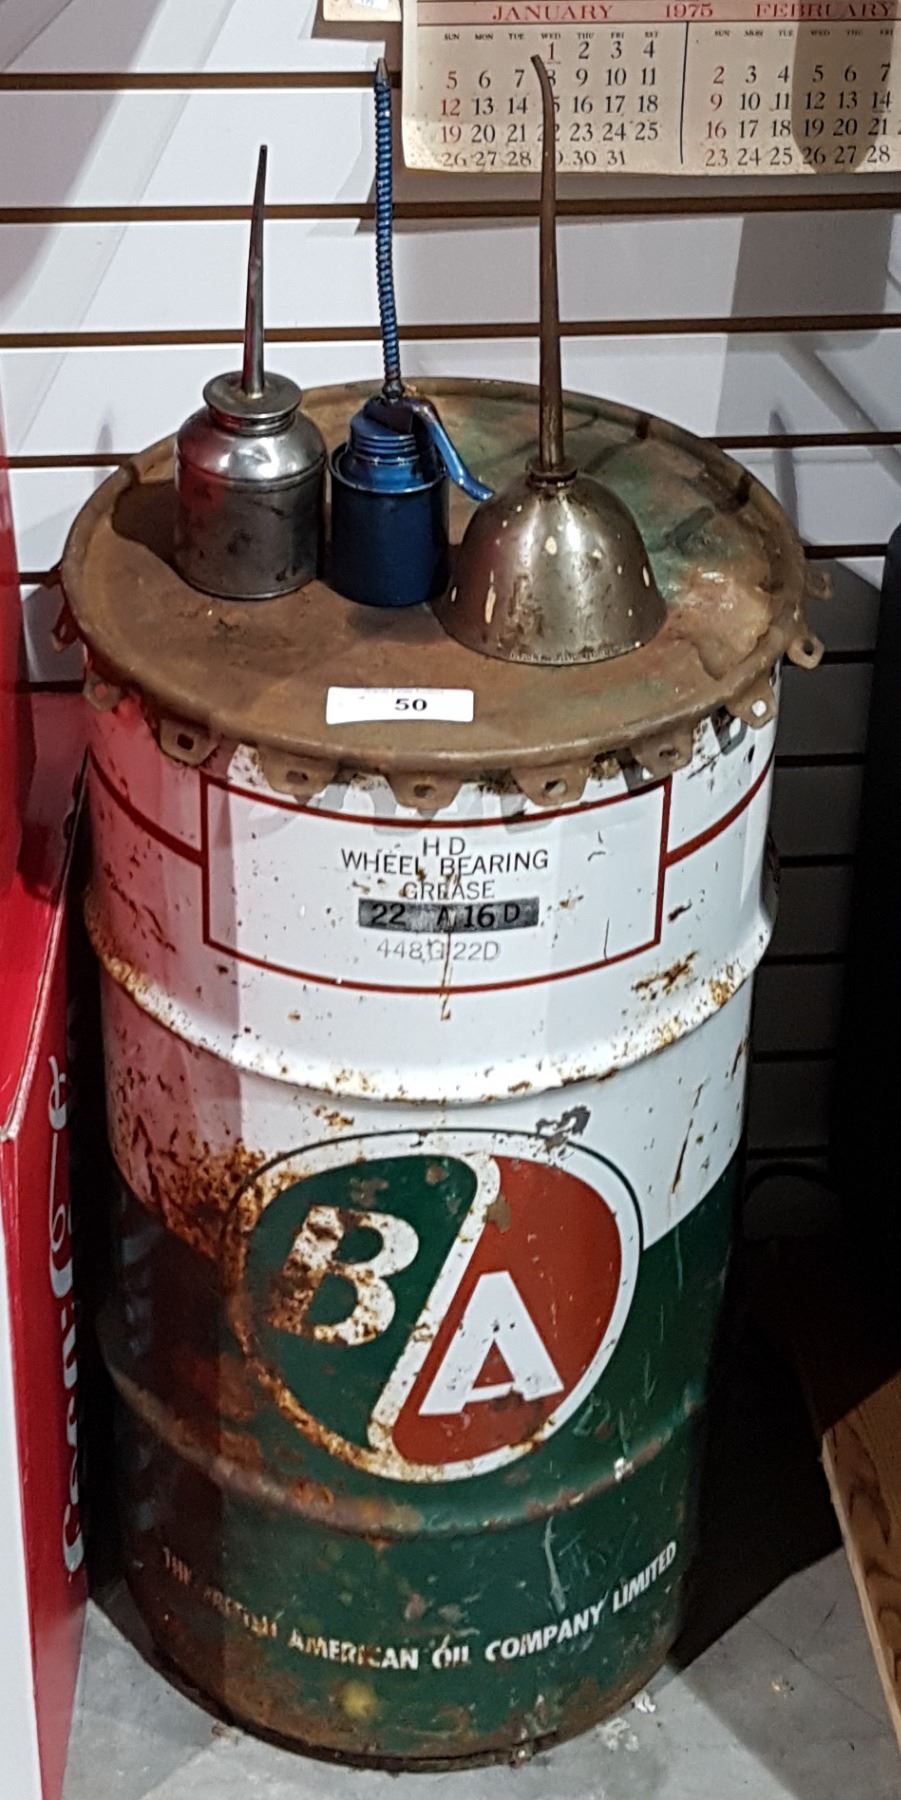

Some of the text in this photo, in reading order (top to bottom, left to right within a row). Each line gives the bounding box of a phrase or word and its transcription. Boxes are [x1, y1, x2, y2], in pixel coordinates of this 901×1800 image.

[492, 2, 895, 21] JANUARY 1975 FEBRUARY
[541, 32, 561, 40] WED
[548, 40, 655, 61] 1 2 3 4
[446, 71, 458, 89] 5
[479, 70, 491, 87] 6
[514, 69, 525, 87] 7
[576, 69, 588, 87] 9
[606, 68, 626, 86] 10
[641, 68, 656, 85] 11
[713, 64, 891, 84] 2 3 4 5 6 7
[440, 99, 461, 116] 12
[472, 98, 495, 115] 13
[508, 97, 528, 115] 14
[573, 97, 593, 114] 16
[606, 96, 625, 113] 17
[638, 95, 658, 113] 18
[711, 92, 891, 111] 9 10 11 12 13 14
[441, 125, 461, 143] 19
[472, 125, 496, 142] 20
[507, 124, 526, 141] 21
[570, 123, 593, 141] 23
[602, 123, 626, 141] 24
[635, 122, 658, 140] 25
[706, 121, 726, 139] 16
[739, 121, 758, 138] 17
[771, 120, 791, 137] 18
[804, 119, 824, 137] 19
[833, 119, 857, 136] 20
[868, 119, 887, 136] 21
[442, 152, 467, 168] 26
[474, 151, 497, 167] 27
[507, 151, 532, 166] 28
[572, 151, 596, 166] 30
[607, 150, 626, 166] 31
[705, 145, 890, 167] 23 24 25 26 27 28
[395, 698, 427, 711] 50
[341, 848, 549, 876] WHEEL BEARING
[403, 880, 495, 901] GREASE
[371, 903, 405, 925] 22
[464, 905, 495, 929] 16
[202, 1585, 278, 1639] RITISH
[287, 1628, 418, 1670] AMERICAN
[432, 1633, 470, 1669] OIL
[484, 1602, 605, 1662] COMPANY
[612, 1541, 678, 1613] LIMITED
